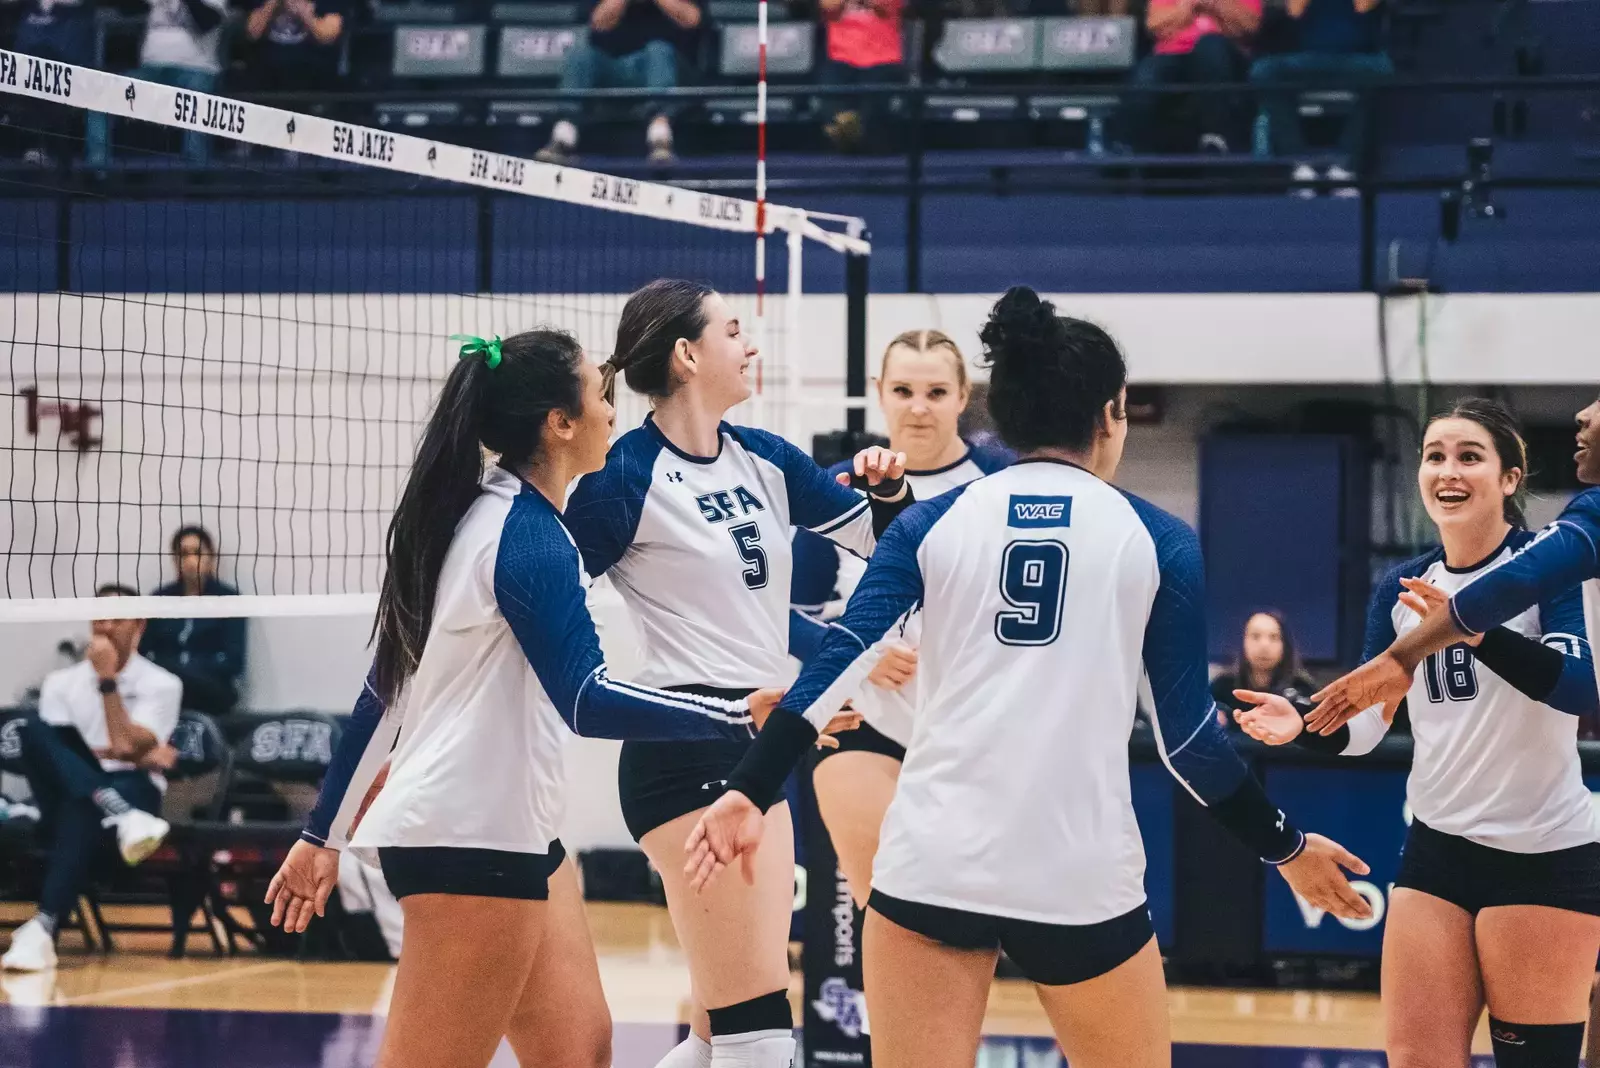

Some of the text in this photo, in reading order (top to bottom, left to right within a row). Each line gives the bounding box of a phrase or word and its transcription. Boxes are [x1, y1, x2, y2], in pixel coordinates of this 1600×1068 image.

[0, 51, 73, 98] FA JACKS
[174, 92, 246, 134] SFA JACKS
[333, 125, 397, 163] SFA JACKS
[693, 484, 766, 524] SFA
[1014, 503, 1065, 519] WAC
[728, 521, 769, 590] 5
[994, 539, 1069, 646] 9
[1423, 641, 1479, 703] 18
[252, 719, 333, 763] SFA
